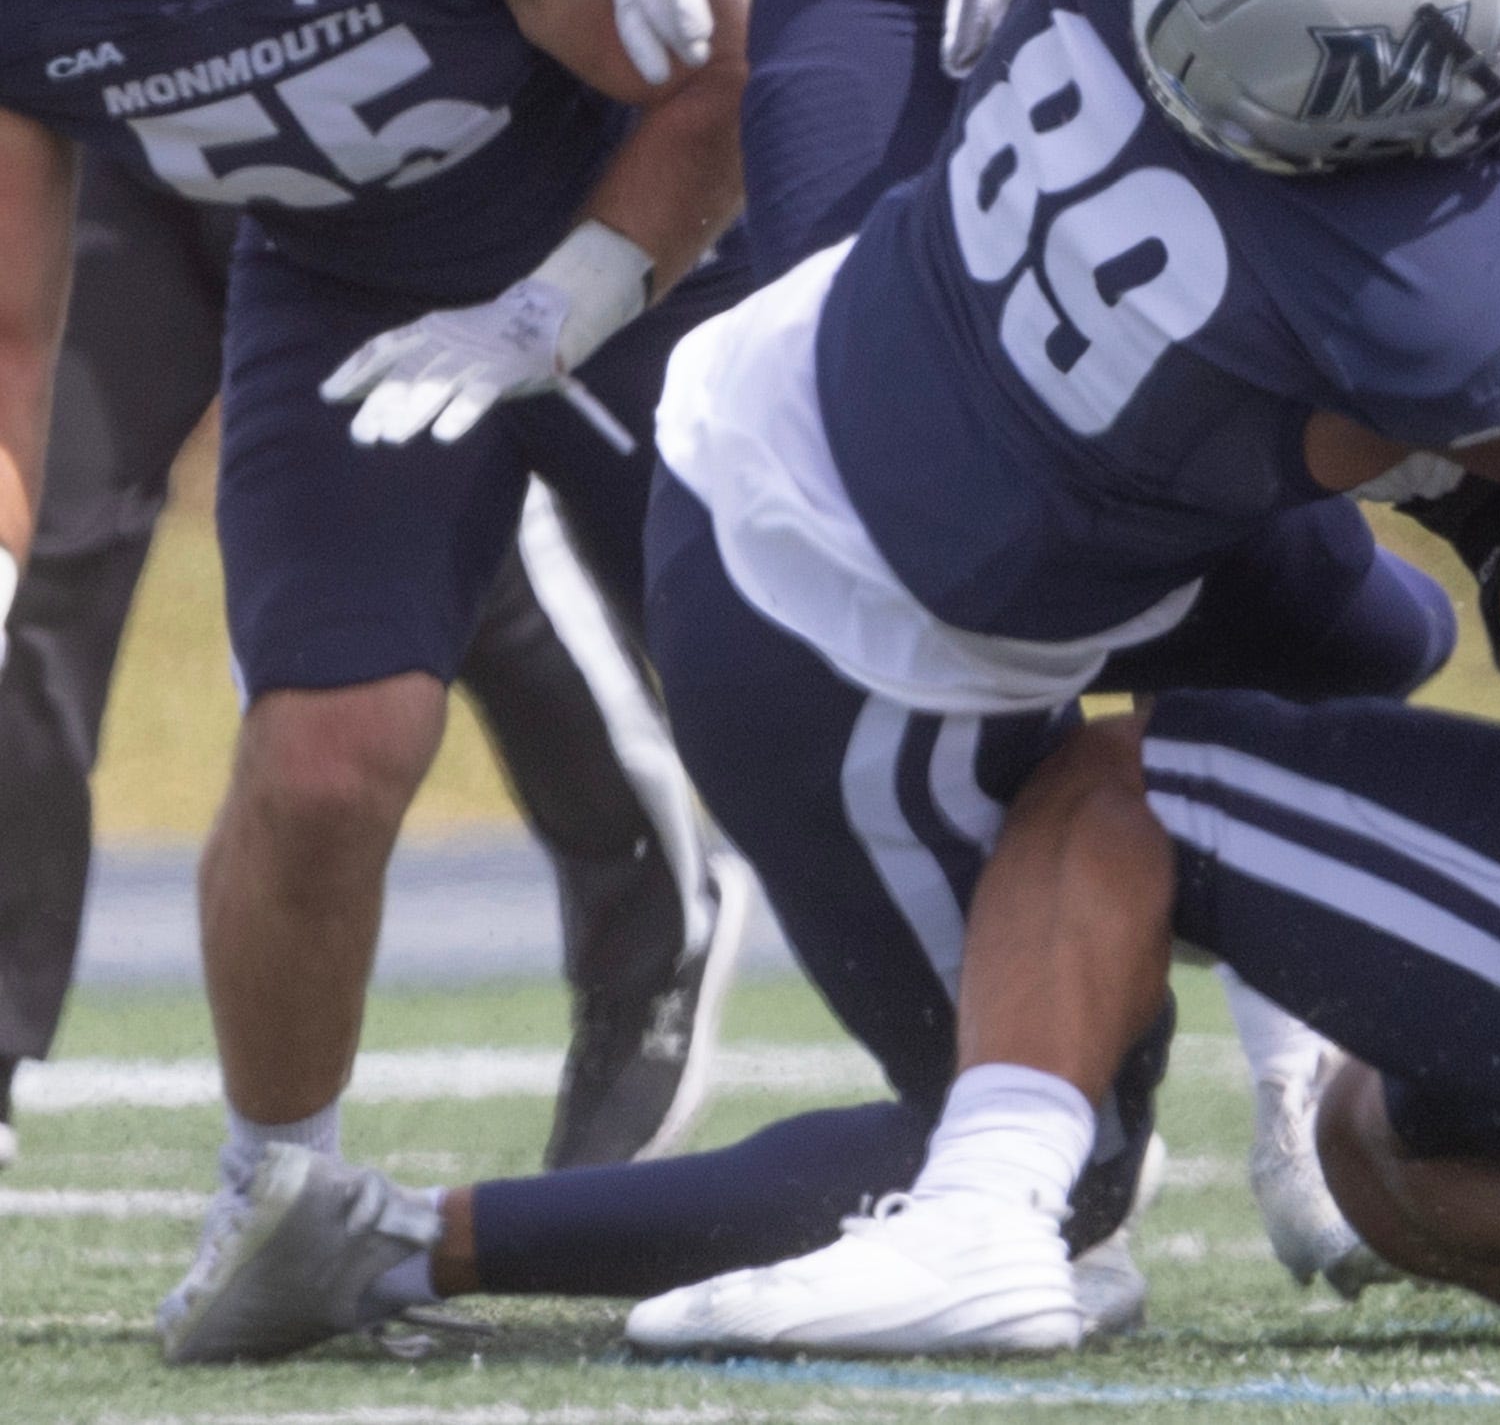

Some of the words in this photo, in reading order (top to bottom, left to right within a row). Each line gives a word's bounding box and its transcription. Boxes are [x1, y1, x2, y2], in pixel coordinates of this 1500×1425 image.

[46, 41, 126, 78] CAA
[102, 2, 384, 117] MONMOUTH
[126, 22, 511, 209] 55
[949, 8, 1229, 438] 89
